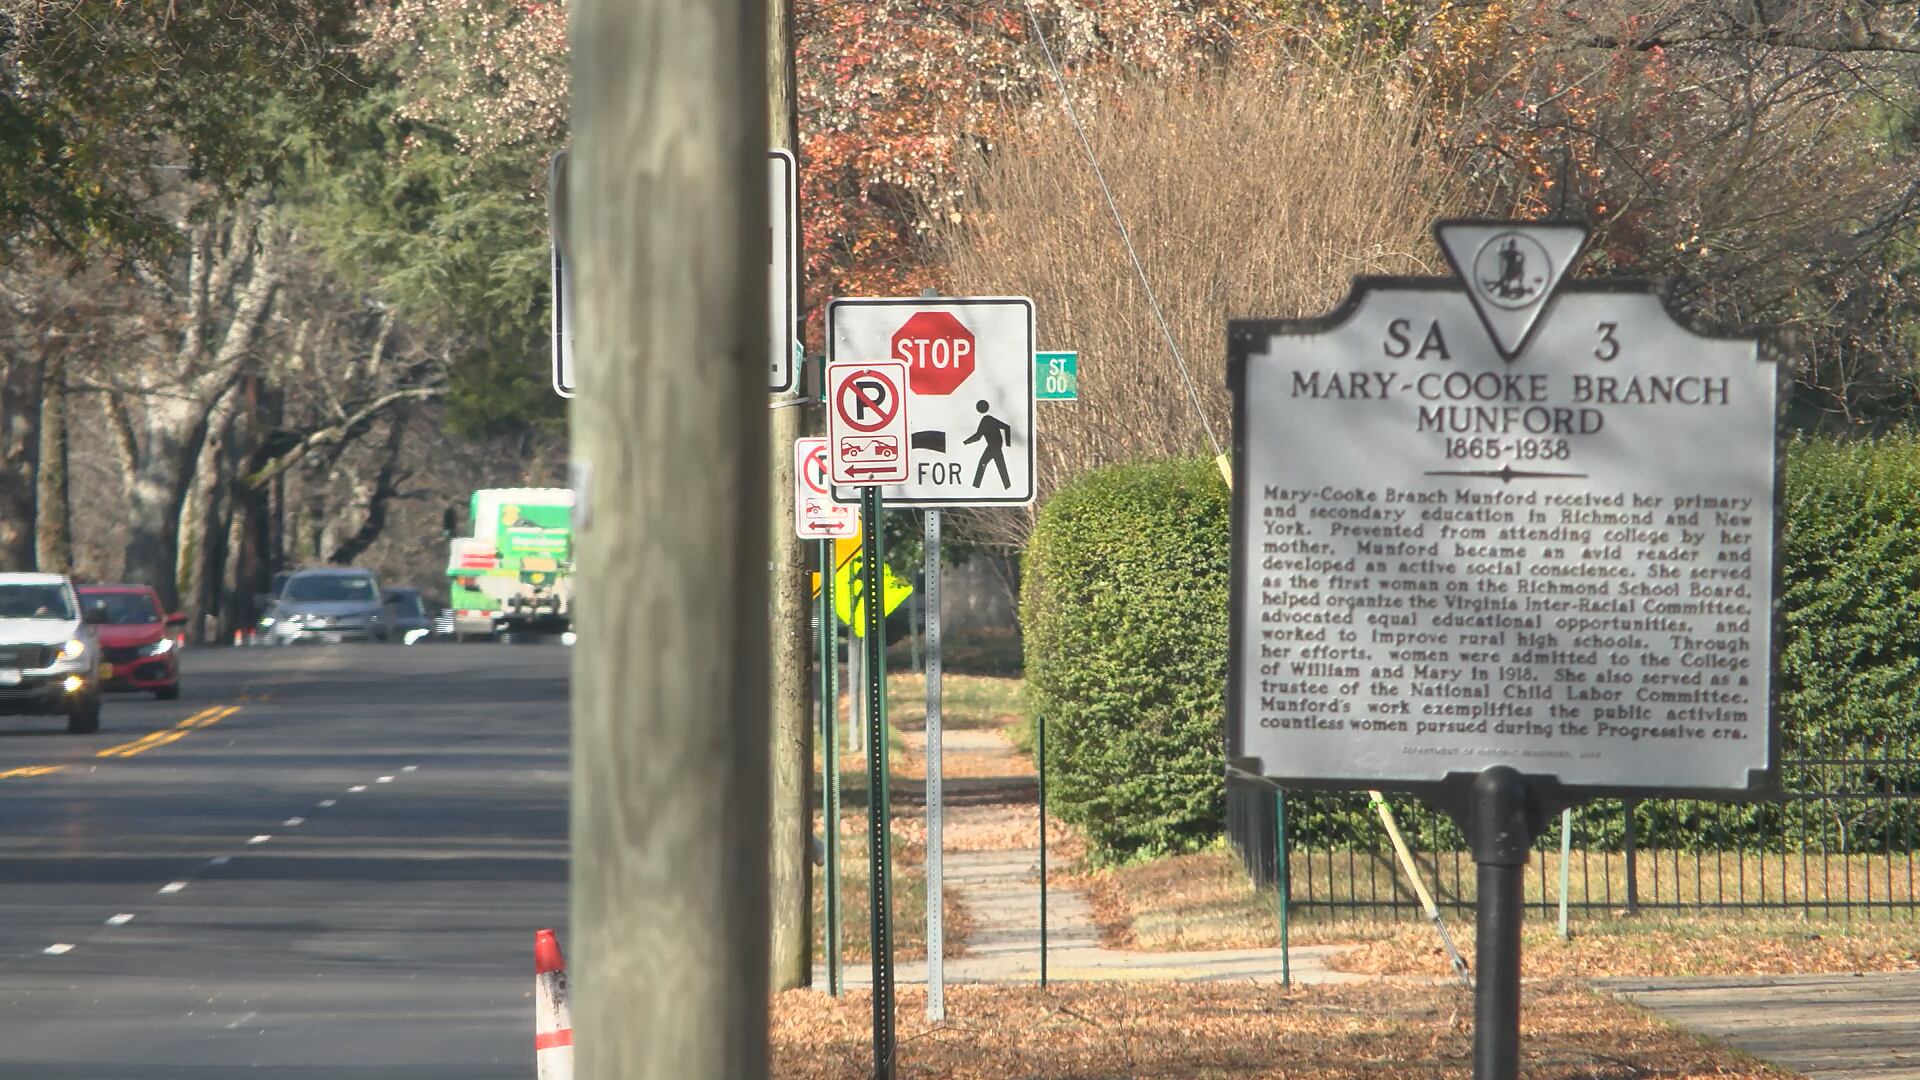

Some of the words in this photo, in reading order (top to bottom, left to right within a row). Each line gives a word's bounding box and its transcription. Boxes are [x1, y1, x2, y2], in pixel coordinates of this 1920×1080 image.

[1383, 319, 1451, 360] SA
[1594, 321, 1620, 361] 3
[898, 338, 970, 369] STOP
[1049, 358, 1067, 376] ST
[1046, 376, 1067, 393] 00
[1291, 371, 1548, 401] MARY-COOKE
[1572, 374, 1730, 405] BRANCH
[1417, 404, 1604, 434] MUNFORD
[1445, 437, 1571, 460] 1865-1938
[918, 462, 961, 485] FOR
[1264, 485, 1376, 503] Mary-Cooke
[1386, 488, 1447, 503] Branch
[1455, 489, 1536, 505] Munford
[1545, 491, 1624, 507] received
[1633, 493, 1663, 508] her
[1674, 494, 1752, 511] primary
[1264, 502, 1296, 517] and
[1310, 503, 1405, 521] secondary
[1421, 505, 1514, 522] education
[1529, 508, 1546, 522] in
[1561, 508, 1652, 524] Richmond
[1666, 510, 1698, 525] and
[1716, 511, 1752, 527] New
[1264, 520, 1311, 535] York.
[1331, 522, 1424, 538] Prevented
[1441, 524, 1486, 539] from
[1499, 525, 1590, 543] attending
[1604, 527, 1668, 545] college
[1682, 529, 1705, 546] by
[1721, 530, 1752, 545] her
[1357, 540, 1438, 556] Munford
[1455, 542, 1526, 558] became
[1543, 547, 1564, 559] an
[1582, 545, 1621, 560] avid
[1637, 546, 1699, 561] reader
[1717, 547, 1751, 562] and
[1263, 555, 1355, 573] developed
[1366, 560, 1386, 572] an
[1399, 558, 1456, 573] active
[1467, 559, 1521, 575] social
[1530, 561, 1635, 577] conscience.
[1648, 563, 1680, 578] She
[1690, 564, 1751, 579] served
[1263, 576, 1280, 588] as
[1290, 574, 1318, 589] the
[1330, 575, 1369, 590] first
[1379, 579, 1438, 591] woman
[1446, 580, 1468, 592] on
[1478, 578, 1507, 592] the
[1518, 578, 1608, 595] Richmond
[1619, 580, 1679, 596] School
[1263, 591, 1320, 609] helped
[1327, 592, 1402, 610] organize
[1409, 594, 1437, 609] the
[1444, 595, 1517, 613] Virginia
[1526, 597, 1634, 613] Inter-Racial
[1262, 608, 1353, 624] advocated
[1367, 610, 1416, 628] equal
[1432, 612, 1541, 628] educational
[1716, 617, 1749, 632] and
[1262, 626, 1325, 642] worked
[1339, 628, 1357, 642] to
[1372, 628, 1447, 646] improve
[1460, 630, 1504, 645] rural
[1518, 631, 1557, 649] high
[1574, 633, 1648, 648] schools.
[1670, 635, 1749, 652] Through
[1262, 643, 1291, 658] her
[1389, 649, 1448, 661] women
[1459, 650, 1500, 662] were
[1512, 648, 1597, 664] admitted
[1611, 650, 1629, 665] to
[1640, 651, 1670, 666] the
[1681, 652, 1749, 669] College
[1261, 661, 1280, 676] of
[1291, 662, 1360, 677] William
[1371, 663, 1403, 678] and
[1414, 664, 1462, 682] Mary
[1472, 665, 1488, 680] in
[1555, 667, 1586, 682] She
[1596, 668, 1633, 683] also
[1642, 669, 1701, 684] served
[1711, 673, 1729, 685] as
[1738, 674, 1749, 685] a
[1261, 679, 1328, 695] trustee
[1340, 681, 1359, 695] of
[1370, 681, 1398, 696] the
[1411, 682, 1489, 698] National
[1503, 684, 1552, 699] Child
[1567, 685, 1622, 701] Labor
[1636, 687, 1748, 703] Committee.
[1261, 697, 1350, 713] Munford's
[1368, 699, 1410, 714] work
[1423, 700, 1532, 719] exemplifies
[1550, 703, 1579, 718] the
[1594, 704, 1651, 721] public
[1667, 705, 1747, 721] activism
[1260, 715, 1344, 731] countless
[1349, 720, 1408, 732] women
[1416, 718, 1487, 735] pursued
[1494, 720, 1552, 736] during
[1559, 721, 1588, 736] the
[1597, 722, 1705, 740] Progressive
[1712, 727, 1747, 739] era.
